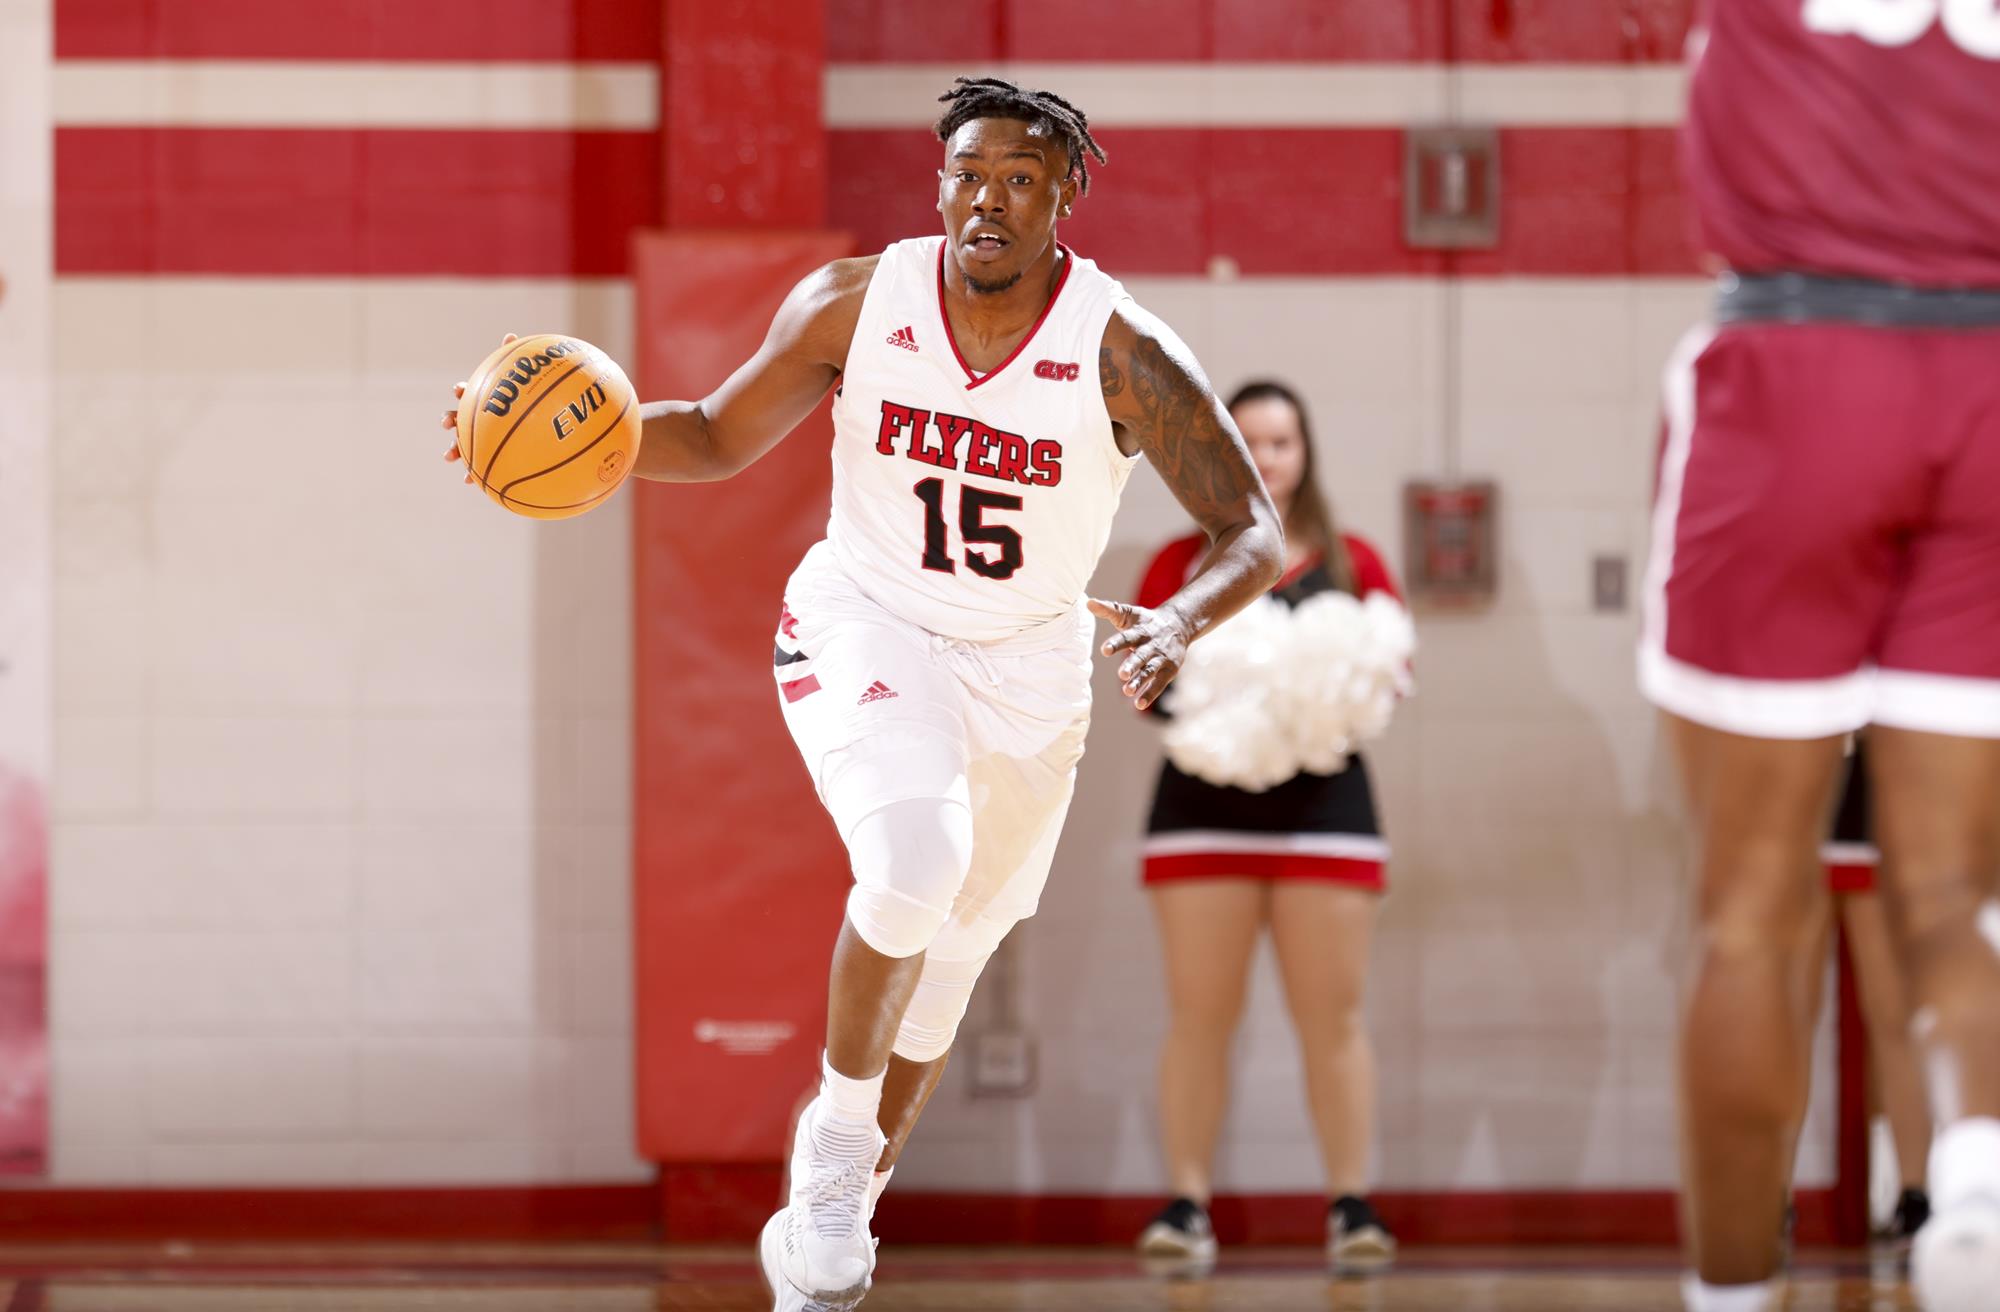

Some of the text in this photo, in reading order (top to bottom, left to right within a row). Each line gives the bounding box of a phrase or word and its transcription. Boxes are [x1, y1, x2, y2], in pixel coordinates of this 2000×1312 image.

[483, 340, 582, 418] Wilson
[886, 336, 919, 352] adidas
[876, 400, 1062, 487] FLYERS
[913, 476, 1024, 580] 15
[857, 690, 899, 706] adidas
